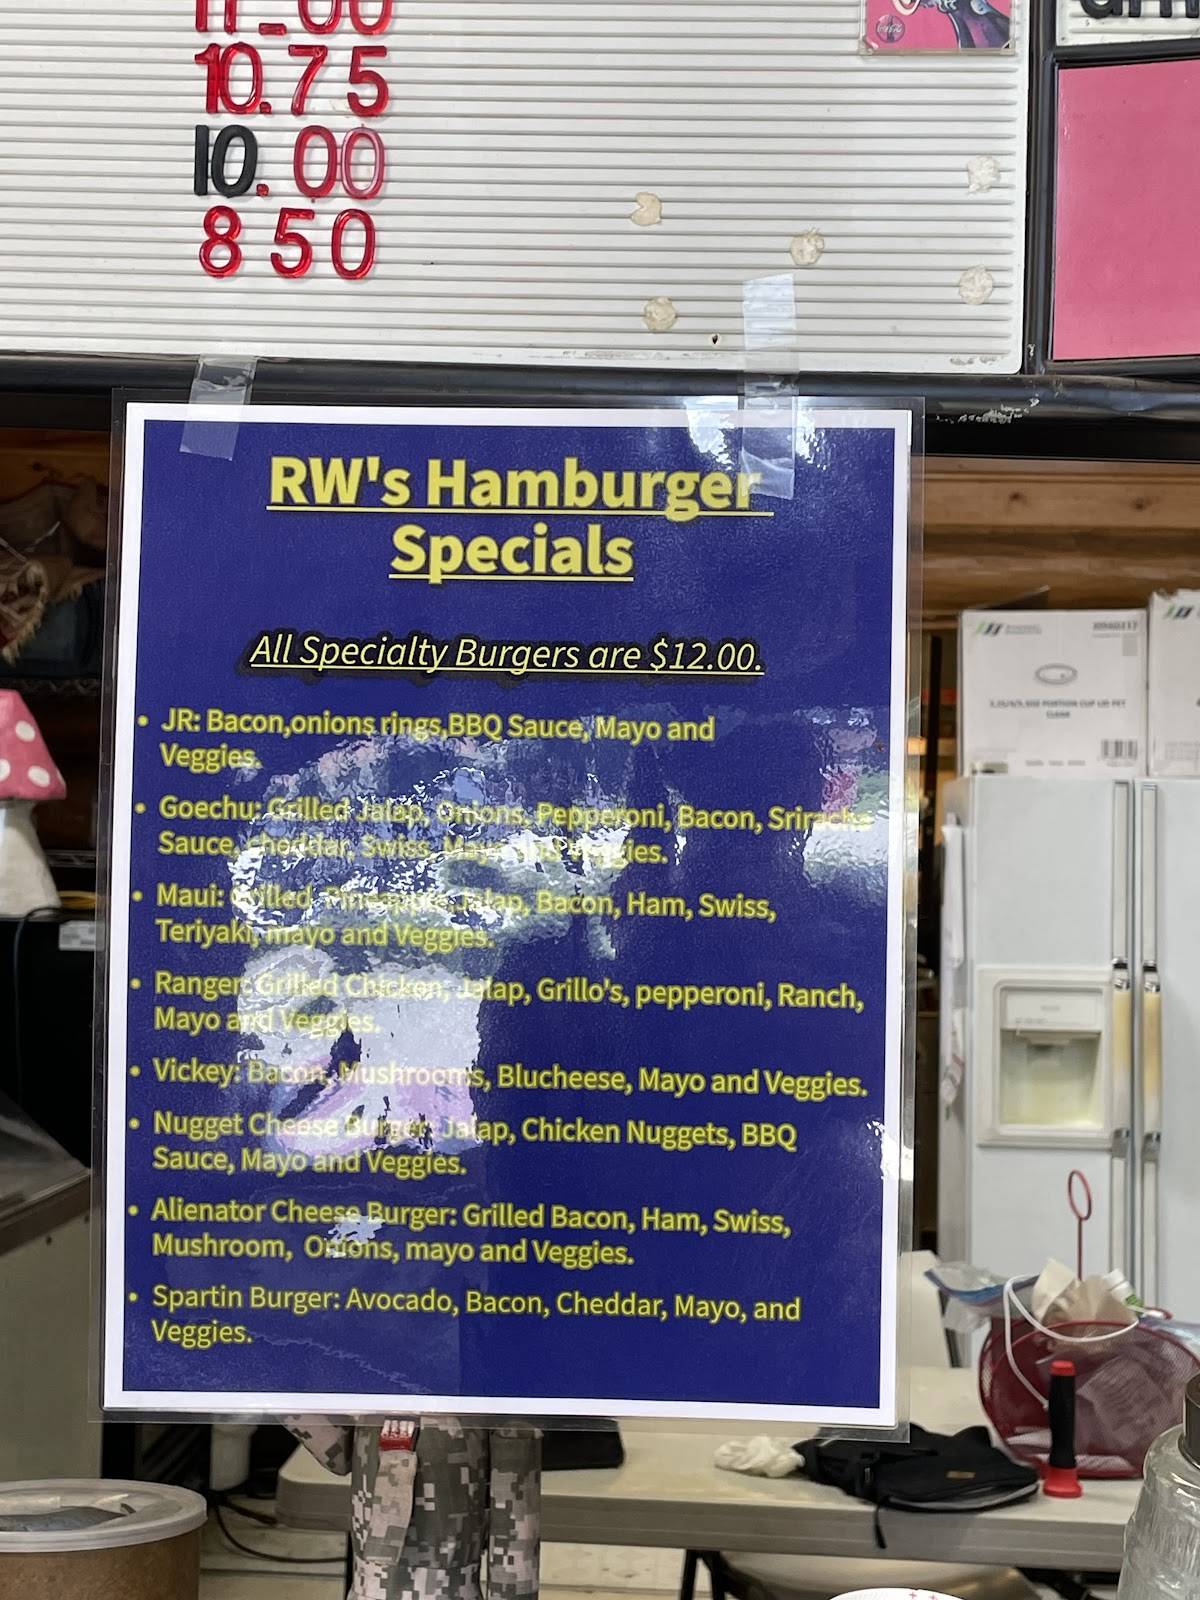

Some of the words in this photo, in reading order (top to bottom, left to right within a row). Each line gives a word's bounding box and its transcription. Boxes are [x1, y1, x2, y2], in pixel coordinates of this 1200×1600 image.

[270, 455, 411, 505] RW's
[427, 456, 763, 522] Hamburger
[391, 522, 634, 584] Specials
[249, 634, 293, 664] All
[300, 635, 448, 672] Specialty
[454, 638, 579, 675] Burgers
[589, 642, 640, 670] are
[650, 640, 764, 673] $12.00.
[161, 708, 200, 732] JR:
[507, 714, 590, 742] Sauce,
[595, 716, 662, 746] Mayo
[667, 716, 716, 742] and
[160, 743, 262, 773] Veggies.
[160, 795, 261, 820] Goechu:
[267, 796, 349, 822] Grilled
[537, 801, 672, 832] Pepperoni,
[678, 805, 763, 835] Bacon,
[159, 831, 238, 860] Sauce,
[513, 837, 563, 864] nd
[156, 882, 224, 908] Maui:
[537, 890, 622, 919] Bacon,
[627, 892, 694, 921] Ham,
[698, 893, 778, 924] Swiss,
[155, 918, 259, 949] Teriyaki,
[265, 924, 336, 950] mayo
[341, 920, 388, 946] and
[394, 923, 496, 953] Veggies.
[155, 970, 253, 1000] Ranger:
[256, 973, 338, 998] Grilled
[457, 975, 532, 1007] Jalap,
[536, 977, 630, 1008] Grillo's,
[635, 982, 773, 1012] pepperoni,
[777, 983, 865, 1014] Ranch,
[154, 1007, 220, 1036] Mayo
[227, 1009, 272, 1033] and
[280, 1011, 383, 1041] Veggies.
[152, 1057, 242, 1088] Vickey:
[339, 1061, 492, 1092] Mushrooms,
[497, 1063, 633, 1095] Blucheese,
[638, 1067, 706, 1098] Mayo
[711, 1069, 759, 1094] and
[764, 1070, 868, 1102] Veggies.
[153, 1111, 243, 1142] Nugget
[249, 1112, 338, 1137] Cheese
[441, 1116, 516, 1146] Jalap,
[522, 1117, 620, 1143] Chicken
[626, 1120, 736, 1151] Nuggets,
[742, 1123, 797, 1152] BBQ
[152, 1147, 235, 1175] Sauce,
[241, 1148, 306, 1177] Mayo
[312, 1149, 360, 1173] and
[367, 1150, 467, 1180] Veggies.
[151, 1198, 263, 1222] Alienator
[270, 1199, 360, 1223] Cheese
[367, 1201, 457, 1232] Burger:
[462, 1203, 544, 1228] Grilled
[551, 1205, 635, 1233] Bacon,
[641, 1207, 707, 1236] Ham,
[713, 1208, 791, 1239] Swiss,
[152, 1233, 293, 1262] Mushroom,
[304, 1235, 399, 1265] Onions,
[405, 1242, 475, 1267] mayo
[480, 1239, 526, 1263] and
[532, 1241, 635, 1270] Veggies.
[152, 1284, 242, 1312] Spartin
[250, 1286, 340, 1315] Burger:
[345, 1288, 459, 1316] Avocado,
[466, 1290, 549, 1318] Bacon,
[557, 1291, 668, 1321] Cheddar,
[674, 1294, 747, 1324] Mayo,
[754, 1297, 801, 1321] and
[152, 1320, 252, 1349] Veggies.
